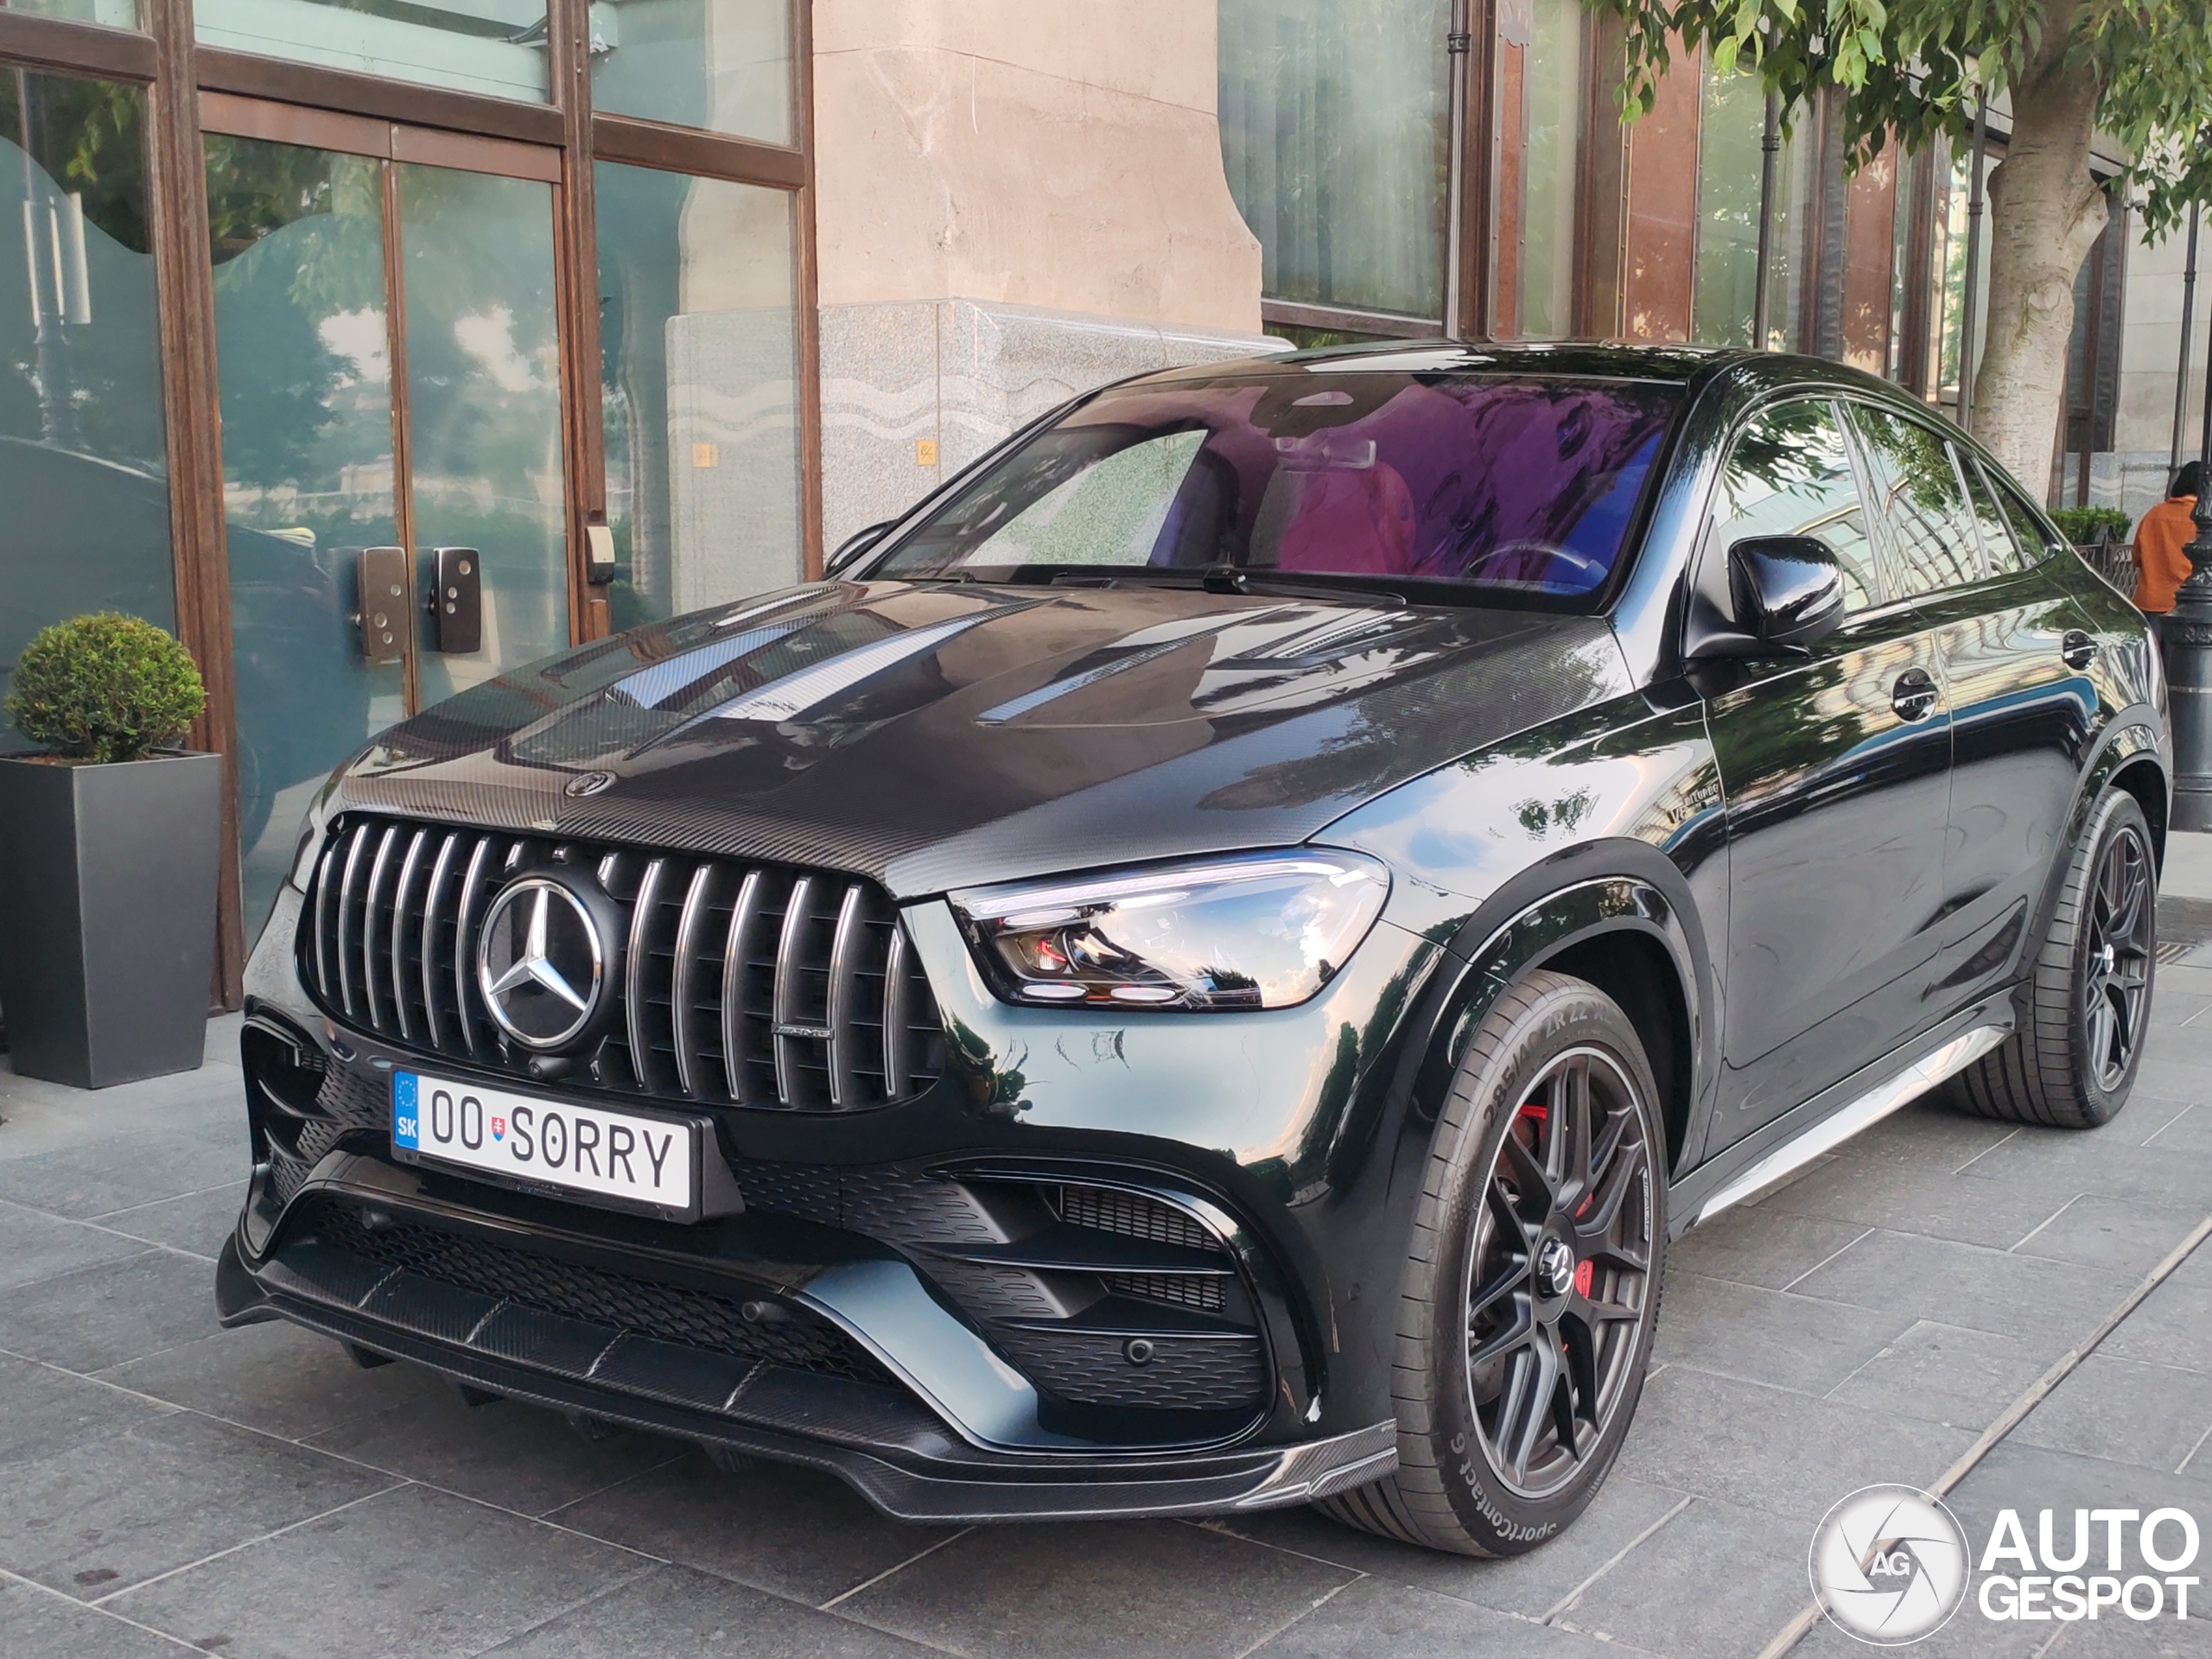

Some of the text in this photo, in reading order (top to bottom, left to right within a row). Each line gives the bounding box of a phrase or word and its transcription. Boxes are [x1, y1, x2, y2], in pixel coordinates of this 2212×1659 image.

[1667, 804, 1688, 824] V8
[1685, 783, 1719, 805] BITURBO
[1545, 1009, 1567, 1039] ZR
[1566, 1001, 1588, 1023] 22
[398, 1116, 416, 1138] SK
[1451, 1433, 1465, 1454] 6
